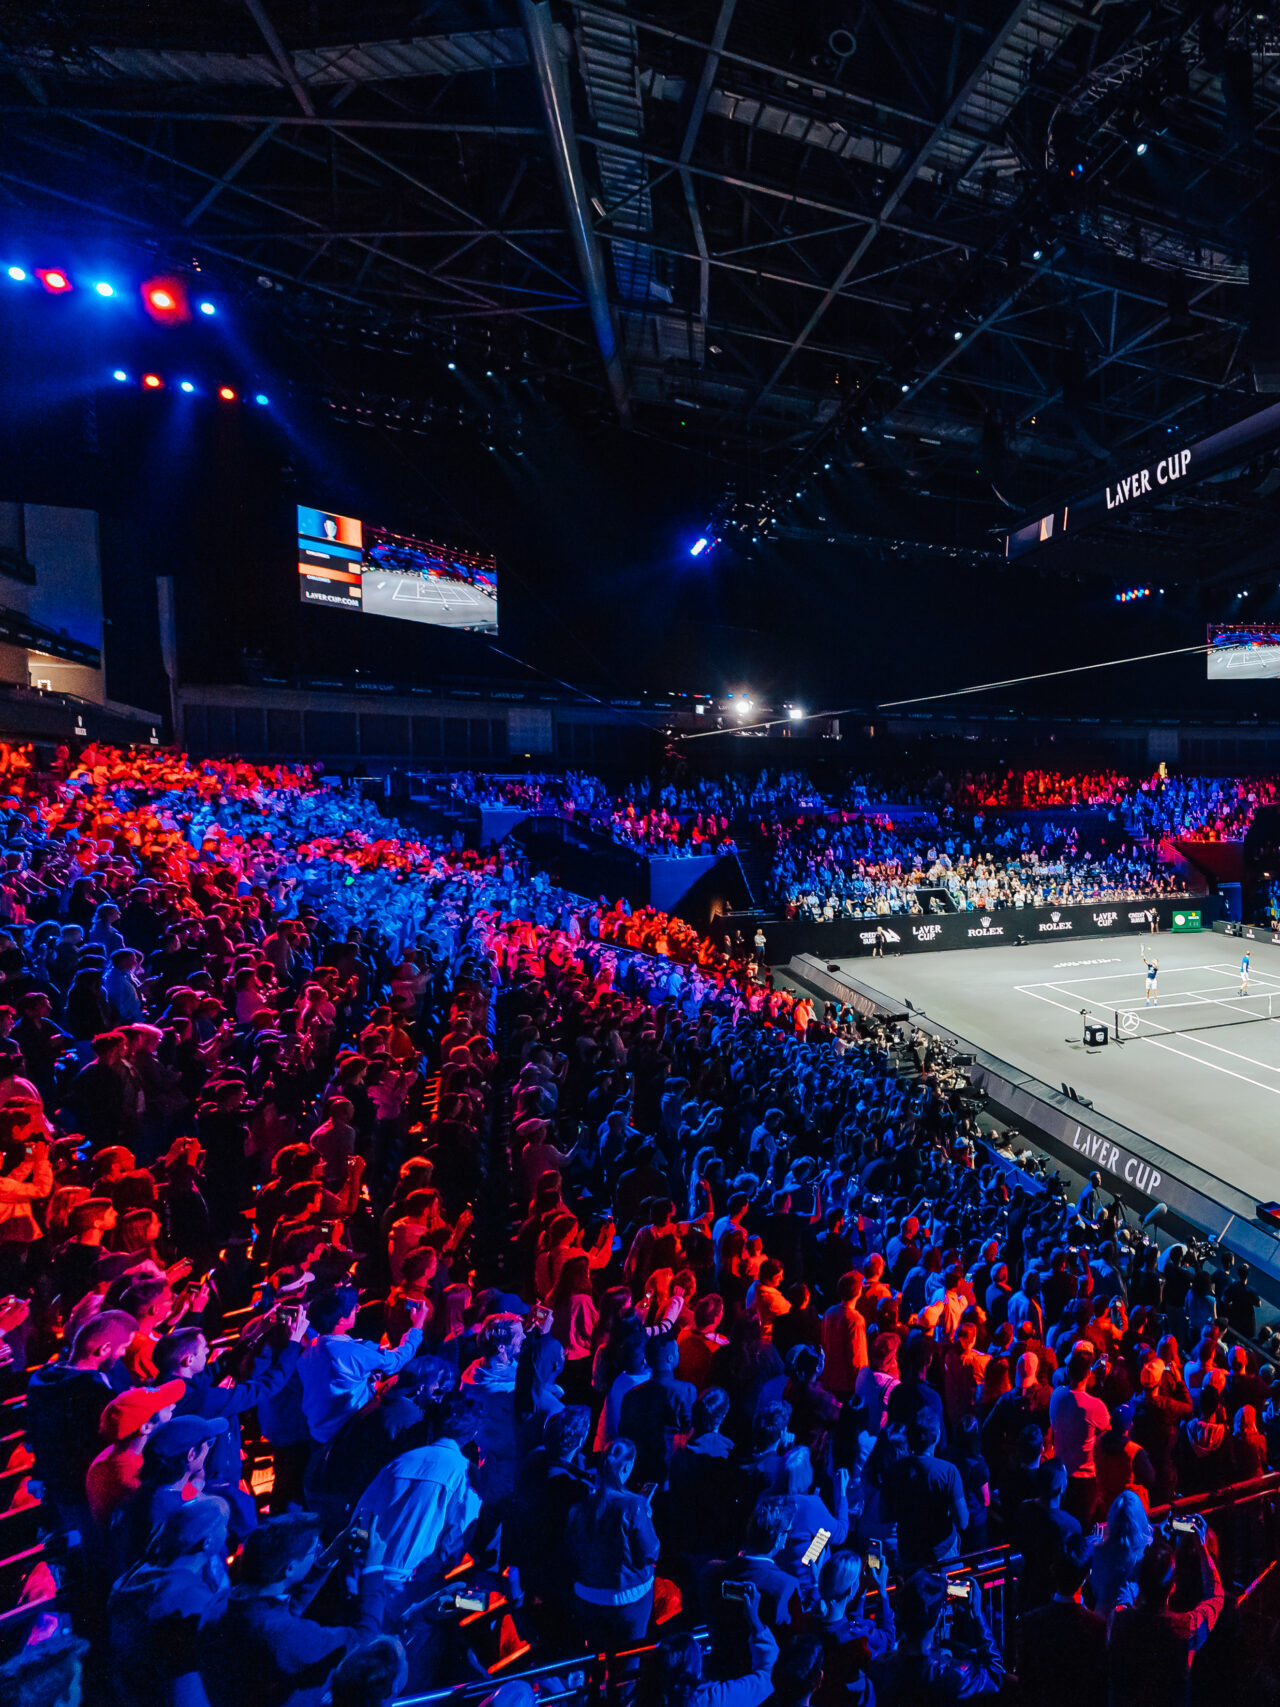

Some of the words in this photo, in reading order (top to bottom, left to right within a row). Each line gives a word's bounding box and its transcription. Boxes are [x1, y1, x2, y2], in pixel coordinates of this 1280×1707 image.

[1105, 469, 1152, 510] LAVER
[1156, 449, 1191, 485] CUP
[1093, 911, 1118, 922] LAVER
[912, 924, 942, 936] LAVER
[967, 926, 1004, 938] ROLEX
[1038, 921, 1073, 932] ROLEX
[1072, 1126, 1120, 1173] LAVER
[1124, 1158, 1161, 1195] CUP
